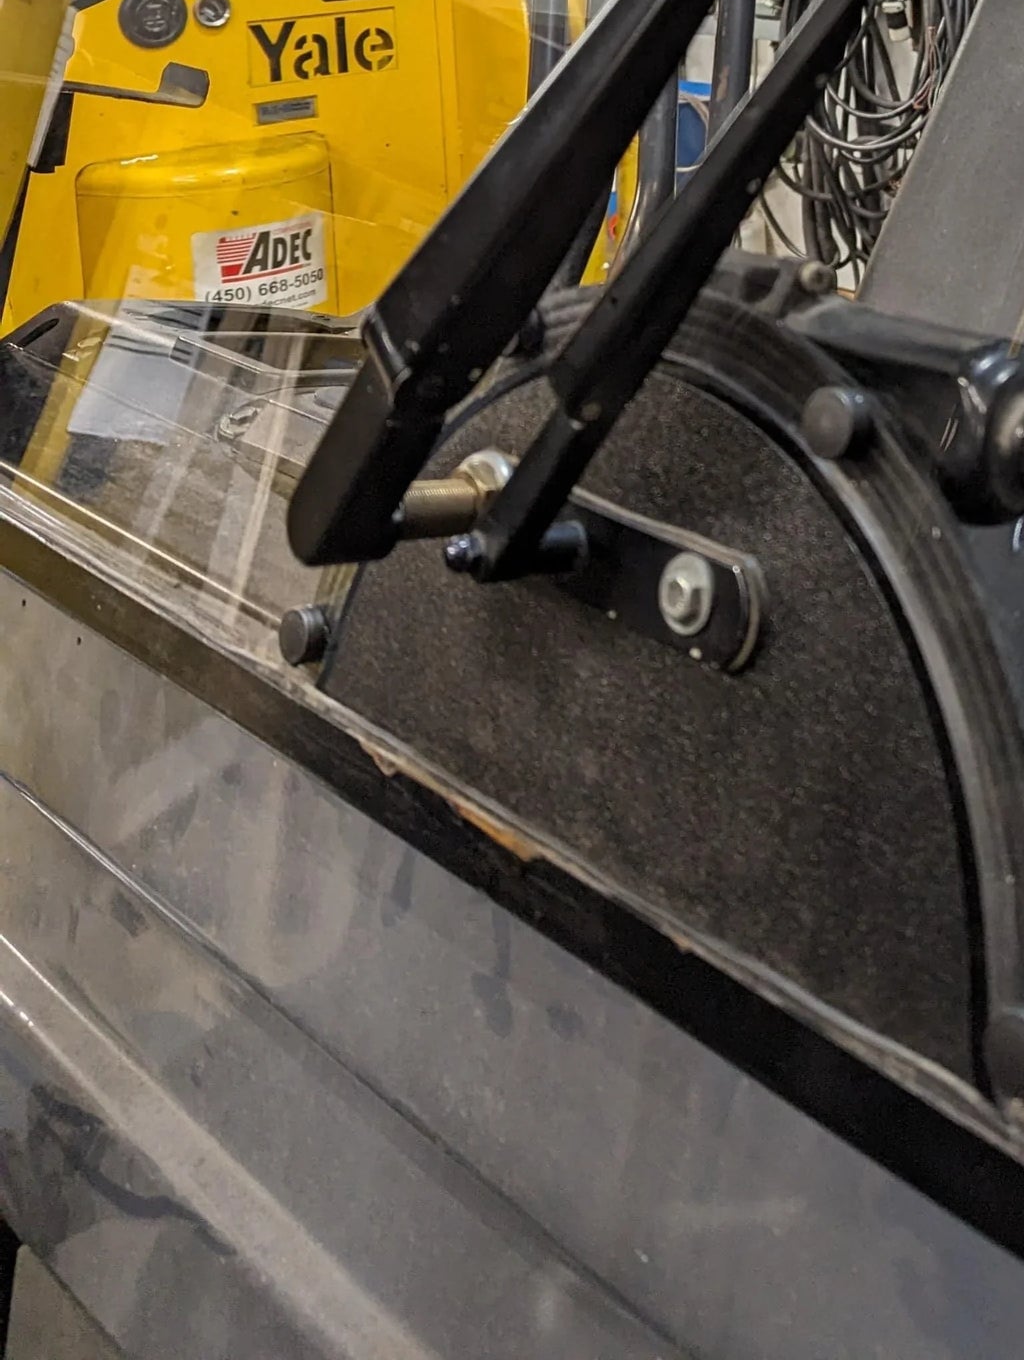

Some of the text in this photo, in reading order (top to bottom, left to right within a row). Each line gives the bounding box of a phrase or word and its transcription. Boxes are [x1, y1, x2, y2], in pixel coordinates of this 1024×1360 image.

[247, 16, 395, 82] Yale
[242, 228, 312, 275] ADEC
[204, 267, 324, 303] (450) 668-5050
[256, 289, 316, 306] decnet.com
